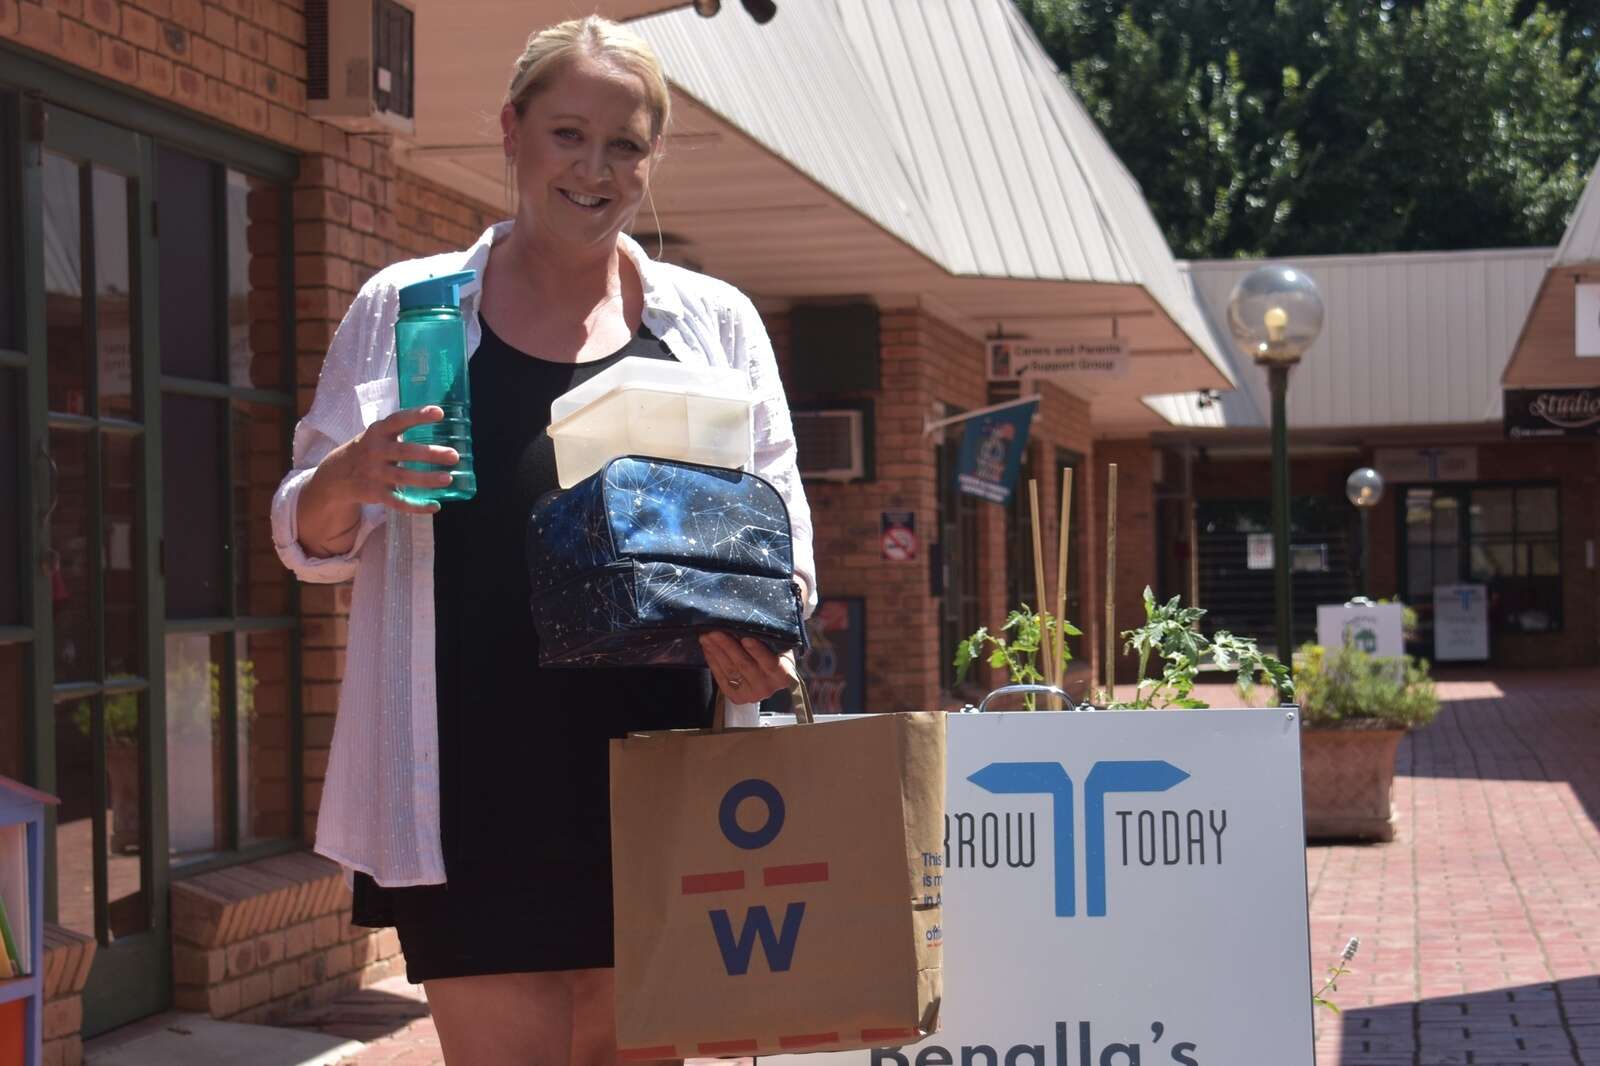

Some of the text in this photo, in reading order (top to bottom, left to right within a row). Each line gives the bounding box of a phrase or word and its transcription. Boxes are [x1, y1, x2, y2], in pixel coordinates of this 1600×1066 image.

[1031, 359, 1115, 372] Support Group
[1054, 345, 1074, 355] and
[718, 778, 786, 850] O
[1115, 808, 1228, 867] TODAY
[708, 901, 806, 977] W
